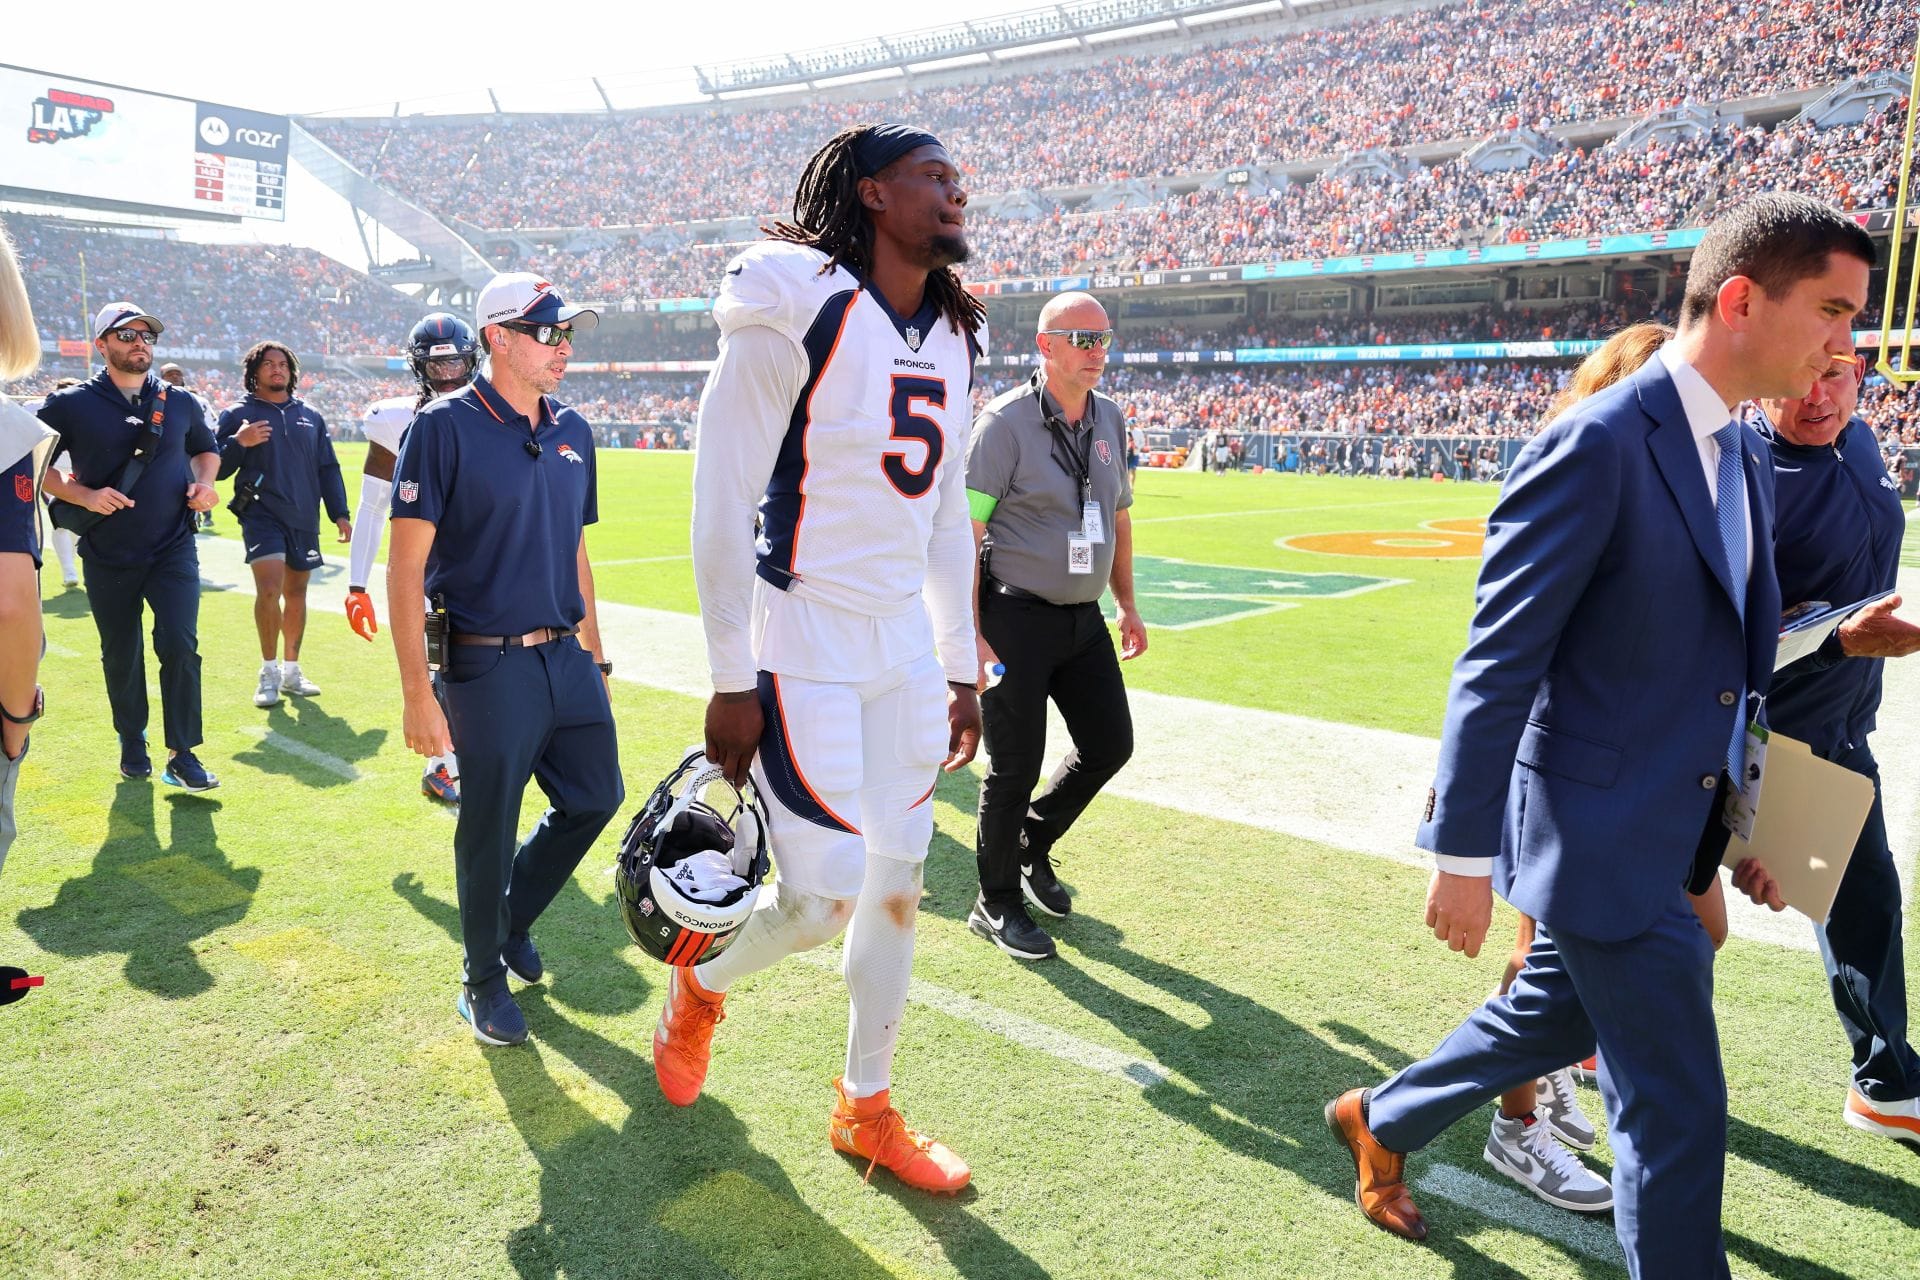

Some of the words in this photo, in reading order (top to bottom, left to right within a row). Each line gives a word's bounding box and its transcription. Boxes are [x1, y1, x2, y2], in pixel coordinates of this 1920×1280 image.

[235, 127, 282, 149] razr
[1882, 212, 1892, 228] 7
[1032, 281, 1044, 292] 21
[1094, 275, 1121, 288] 12:50
[487, 308, 518, 320] BRONCOS
[1568, 343, 1587, 355] JAX
[1185, 351, 1199, 362] YDS
[1214, 350, 1220, 361] 3
[894, 358, 936, 370] BRONCOS
[880, 373, 947, 499] 5
[674, 910, 734, 930] BRONCOS
[660, 926, 671, 938] 5
